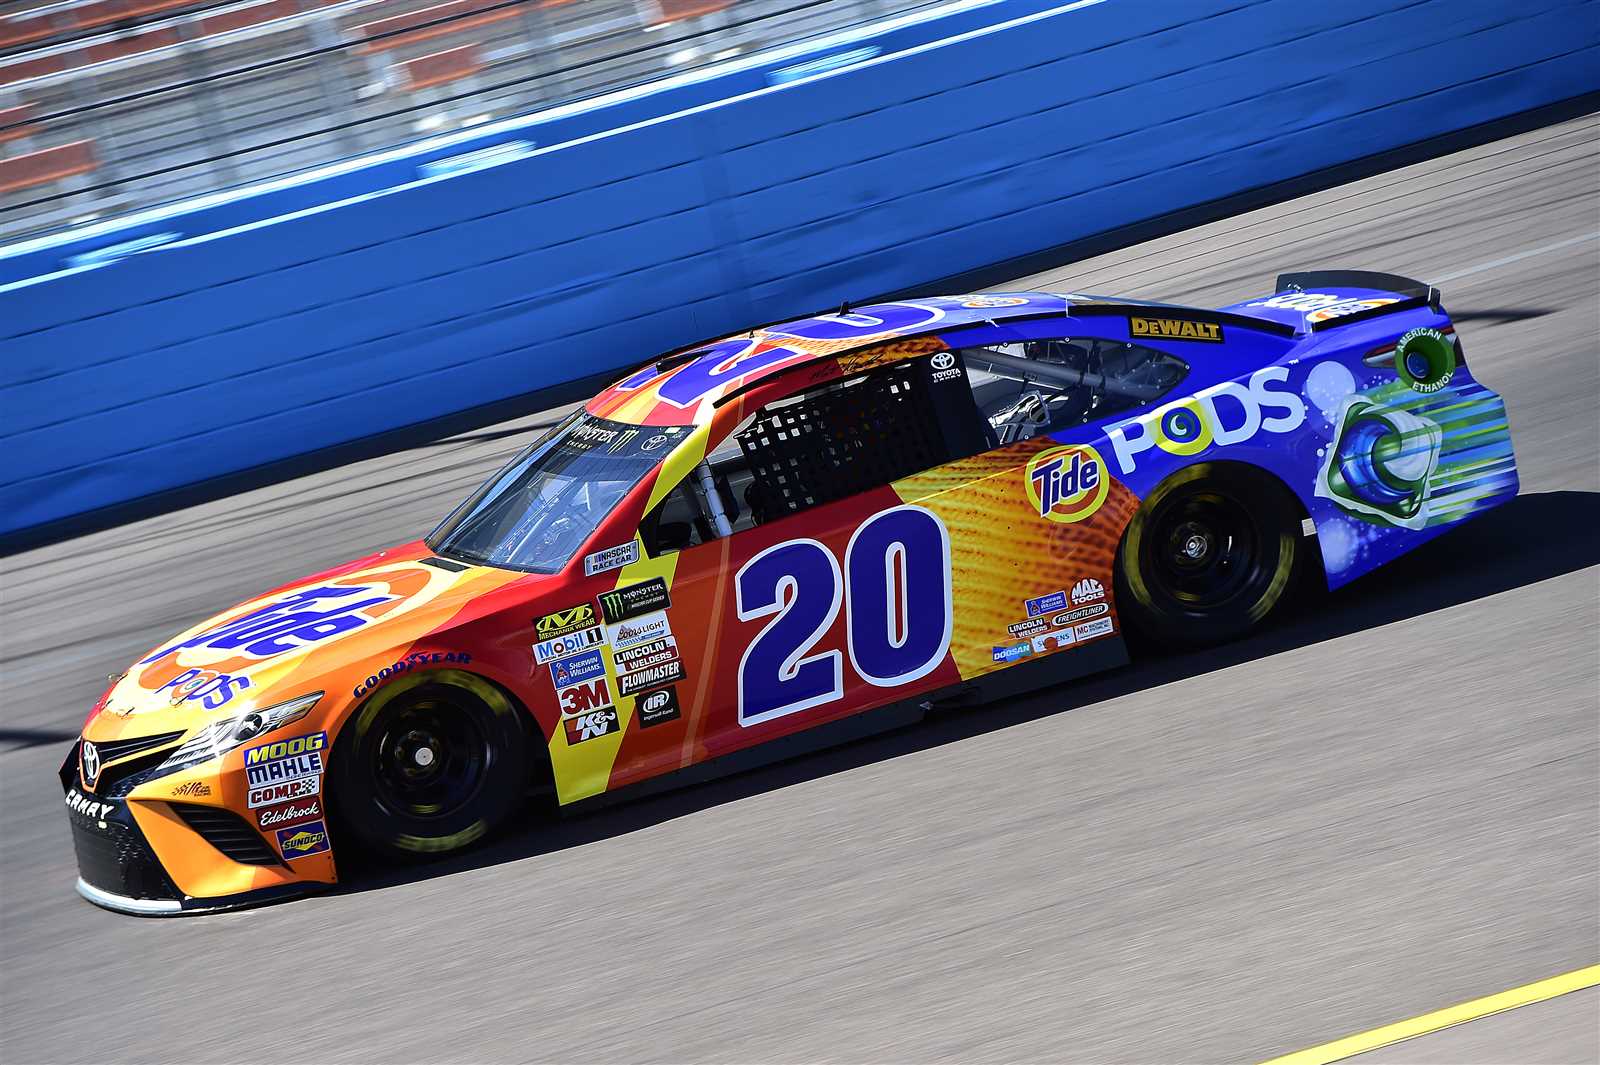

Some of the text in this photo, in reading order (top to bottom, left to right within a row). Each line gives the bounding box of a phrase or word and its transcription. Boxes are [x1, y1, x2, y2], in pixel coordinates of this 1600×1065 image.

[1396, 327, 1442, 353] AMERICAN
[931, 369, 961, 380] TOYOTA
[1412, 370, 1454, 393] ETHANOL
[1102, 366, 1306, 475] PODS
[1032, 452, 1099, 518] Tide
[592, 554, 632, 572] RACE CAR
[597, 544, 632, 562] NASCAR
[623, 583, 664, 600] MONSTER
[1072, 578, 1104, 599] MAC
[1072, 591, 1105, 605] TOOLS
[735, 504, 953, 728] 20
[1057, 605, 1104, 623] FREIGHTLINER
[538, 617, 595, 640] MECHANIX WEAR
[617, 627, 642, 640] Coors
[643, 620, 665, 633] LIGHT
[1008, 618, 1043, 633] LINCOLN
[537, 633, 585, 659] Mobil
[616, 641, 665, 664] LINCOLN
[993, 644, 1030, 660] DOOSAN
[569, 657, 598, 670] SHERWIN
[570, 664, 600, 677] WILLIAMS
[629, 651, 672, 669] WELDERS
[352, 650, 473, 699] GOODYEAR
[622, 661, 680, 695] FLOWMASTER
[561, 679, 611, 715] 3M
[246, 733, 324, 765] MOOG
[247, 753, 322, 785] MAHLE
[65, 788, 115, 820] CAMRY
[251, 782, 302, 804] COMP
[260, 802, 320, 826] Edelbrock
[282, 831, 325, 850] SUNOCO
